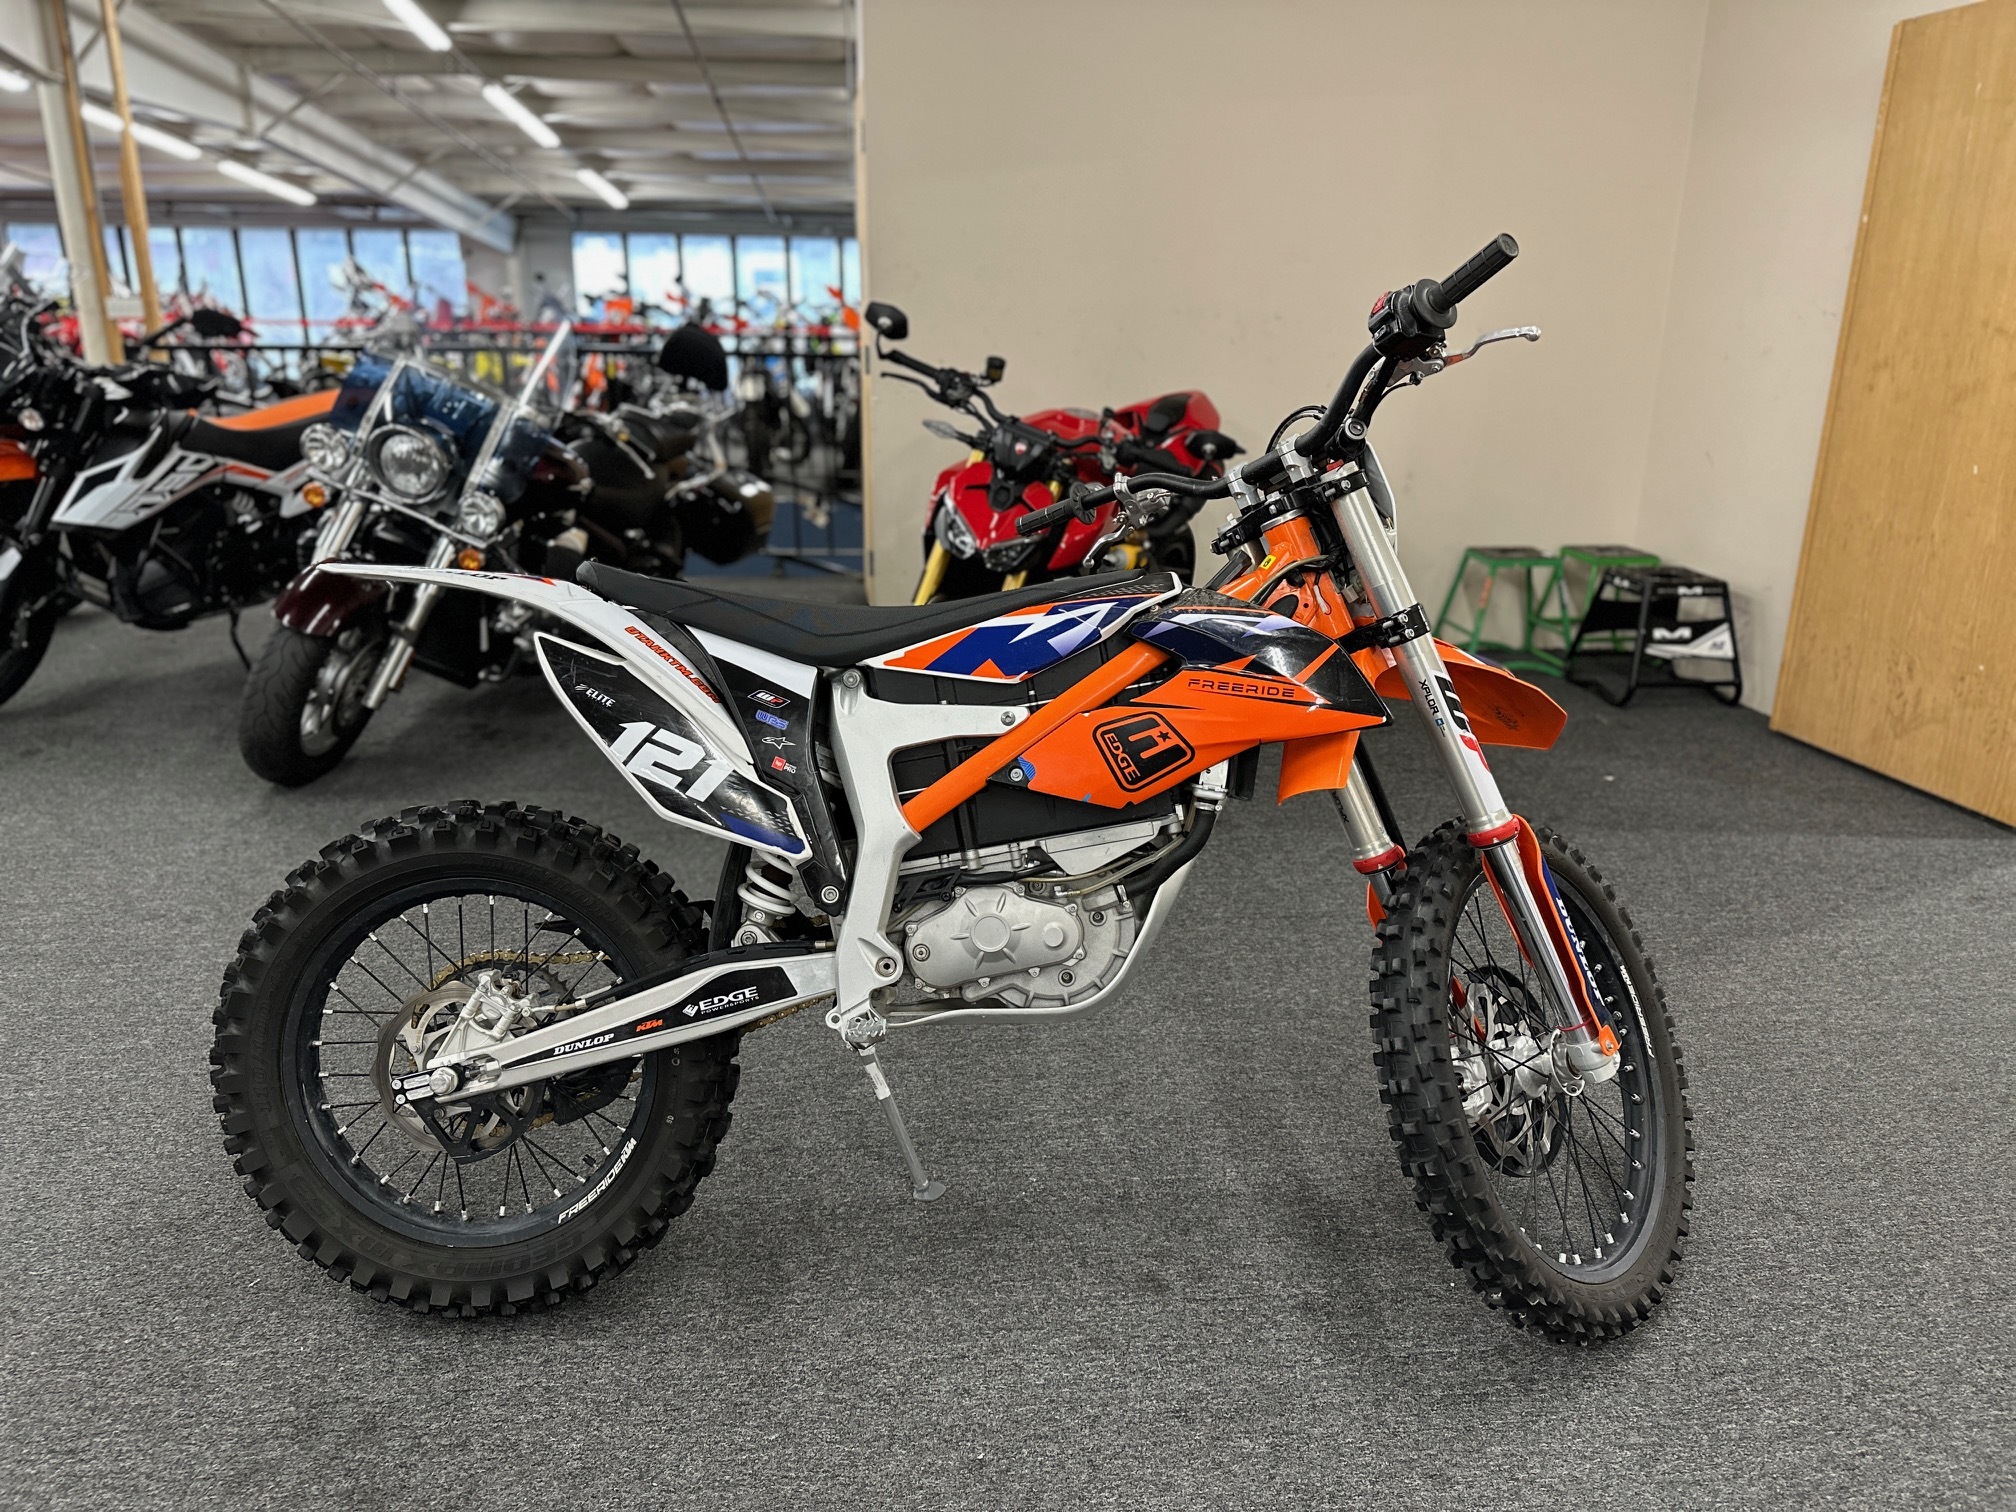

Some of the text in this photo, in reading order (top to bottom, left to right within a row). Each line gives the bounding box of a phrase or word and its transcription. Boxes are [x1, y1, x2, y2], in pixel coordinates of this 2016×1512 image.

[625, 625, 721, 704] UTAHKTM.COM
[585, 687, 616, 708] ELITE
[1187, 678, 1296, 698] FREERIDE
[1418, 678, 1440, 716] XPLOR
[608, 720, 734, 802] 121
[1103, 732, 1141, 782] EDGE
[699, 985, 758, 1011] EDGE
[700, 995, 760, 1015] POWERSPORTS
[635, 1019, 663, 1032] KTM
[552, 1033, 615, 1056] DUNLOP
[557, 1157, 625, 1225] FREERIDE
